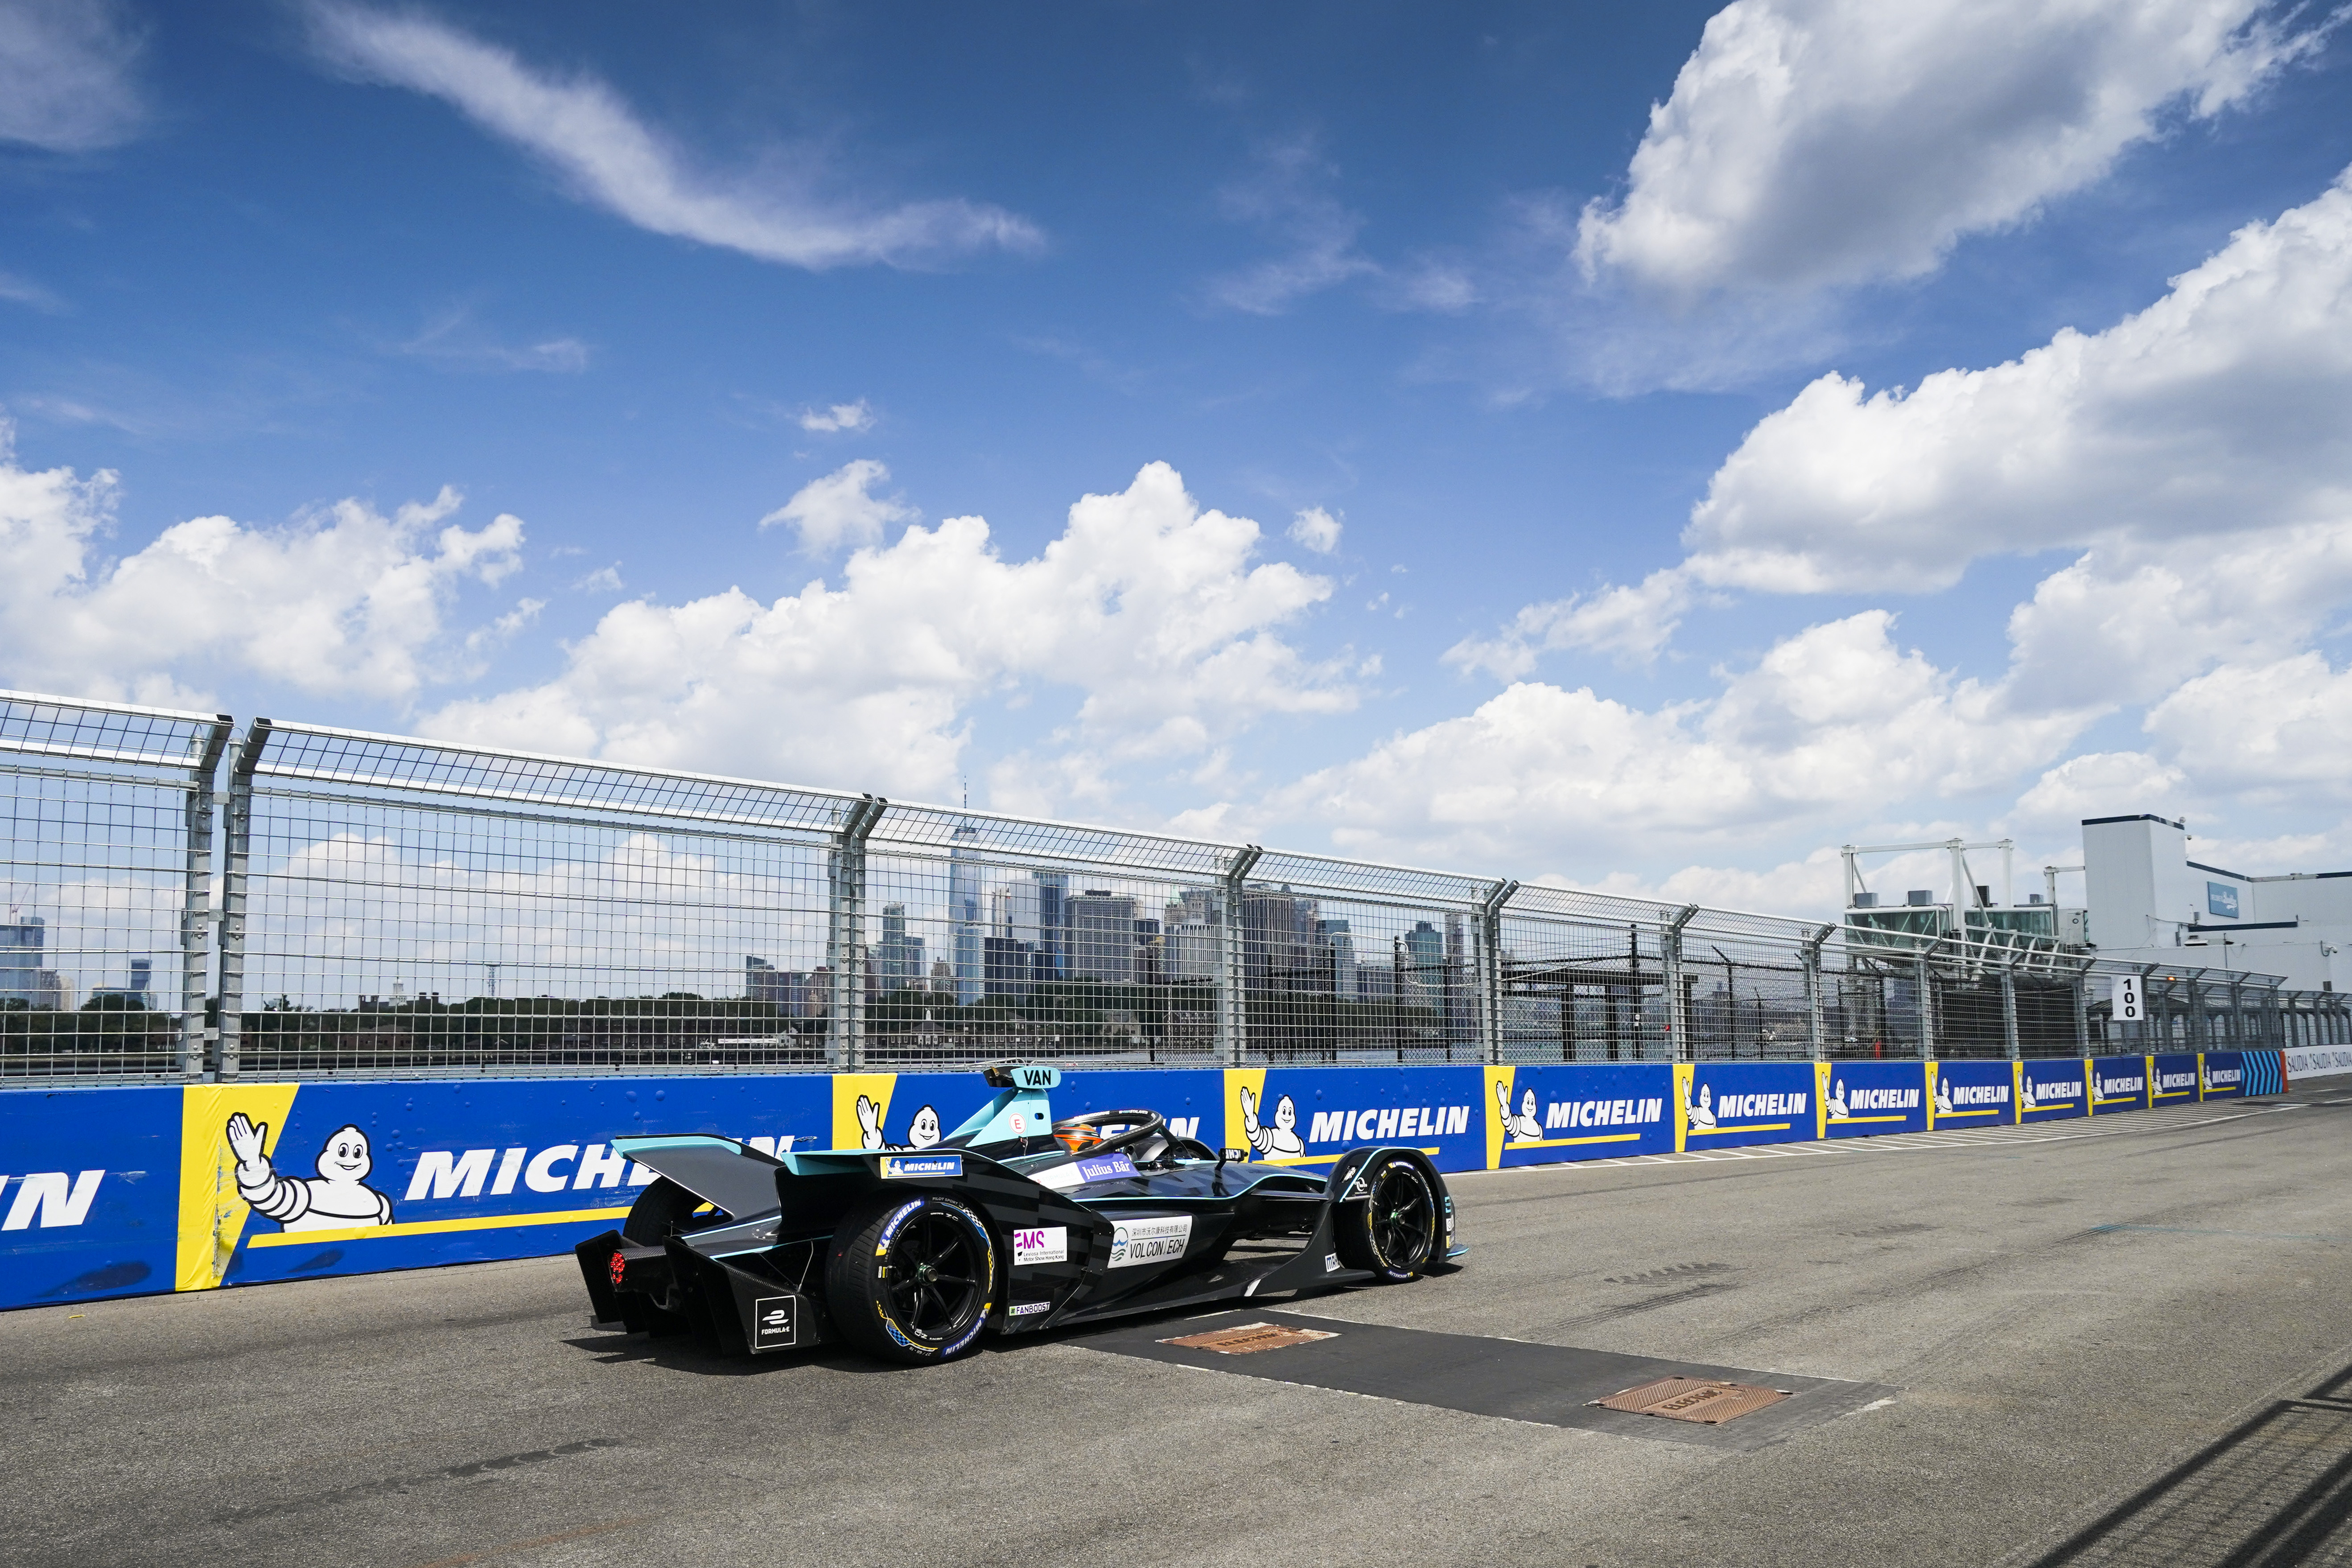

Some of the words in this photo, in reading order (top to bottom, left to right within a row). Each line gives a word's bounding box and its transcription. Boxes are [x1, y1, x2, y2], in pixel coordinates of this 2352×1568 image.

[2124, 978, 2136, 1017] 100
[2288, 1055, 2309, 1073] SAUDIA
[2313, 1053, 2331, 1070] SAUDIA
[2335, 1052, 2352, 1067] SAUDIA
[1024, 1070, 1051, 1086] VAN
[2104, 1077, 2143, 1094] MICHELIN
[2163, 1073, 2195, 1088] MICHELIN
[2213, 1070, 2241, 1083] MICHELIN
[1850, 1089, 1919, 1109] MICHELIN
[1953, 1086, 2009, 1104] MICHELIN
[2036, 1082, 2082, 1100] MICHELIN
[1546, 1098, 1663, 1128] MICHELIN
[1718, 1093, 1807, 1118] MICHELIN
[1309, 1106, 1470, 1143] MICHELIN
[904, 1162, 955, 1171] MICHELIN
[1082, 1163, 1113, 1179] Julius
[1112, 1161, 1131, 1173] Bär
[885, 1199, 922, 1238] MICHELIN
[945, 1318, 982, 1355] MICHELIN
[1661, 1390, 1723, 1411] ELECTRIC
